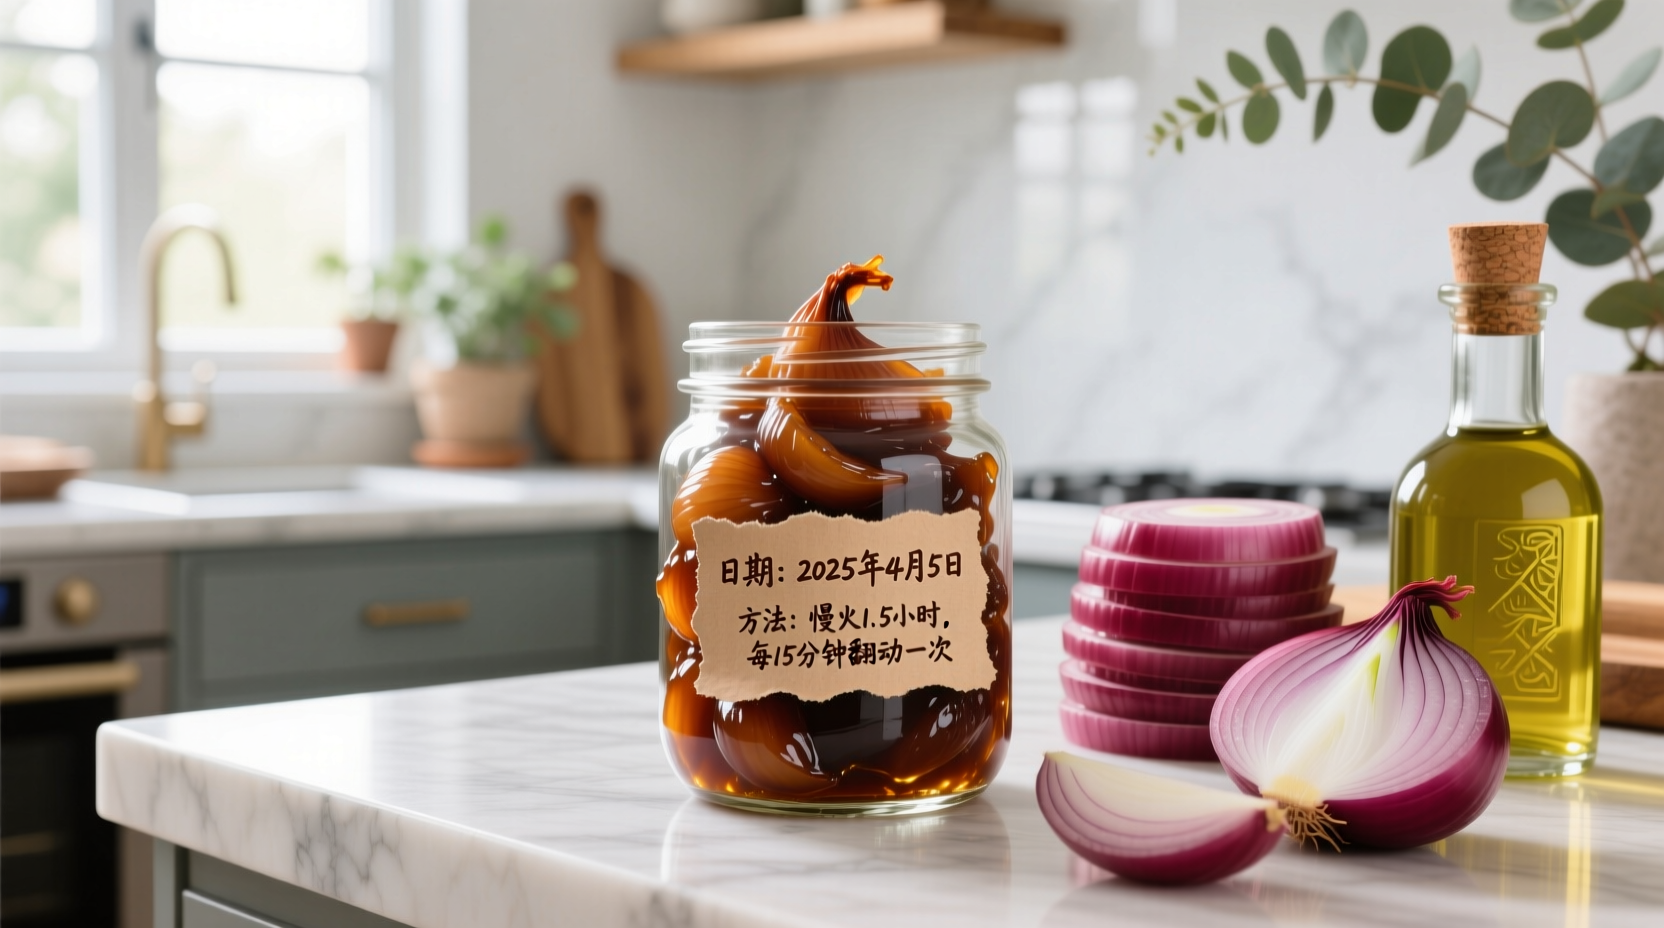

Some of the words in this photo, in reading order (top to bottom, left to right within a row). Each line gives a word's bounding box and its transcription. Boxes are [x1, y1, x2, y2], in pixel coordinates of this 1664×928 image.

[721, 549, 962, 588] 日期：2025年4月5日
[746, 637, 953, 670] 每15分钟翻动一次
